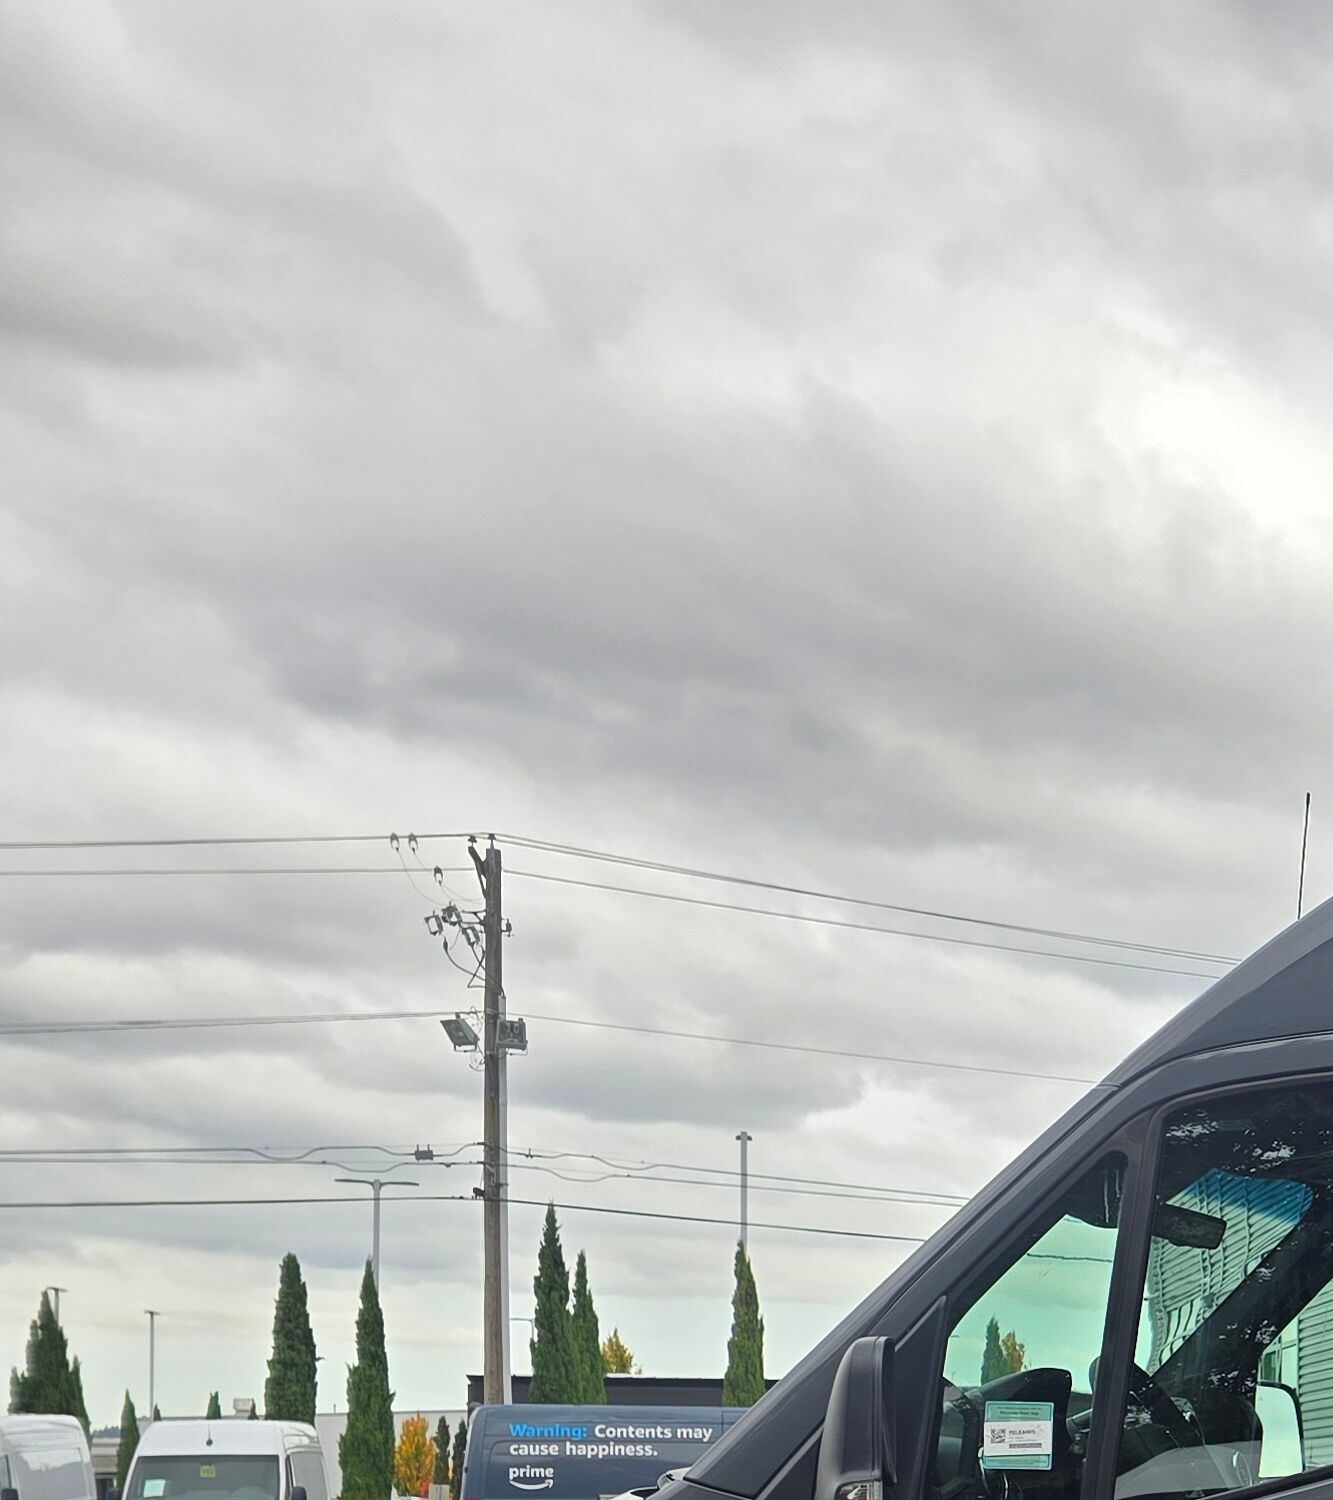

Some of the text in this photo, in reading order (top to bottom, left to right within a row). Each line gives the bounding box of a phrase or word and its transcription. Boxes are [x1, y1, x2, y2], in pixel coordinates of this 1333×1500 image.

[509, 1423, 713, 1442] Warning: Contents may
[509, 1441, 658, 1459] cause happiness.
[508, 1464, 555, 1481] prime
